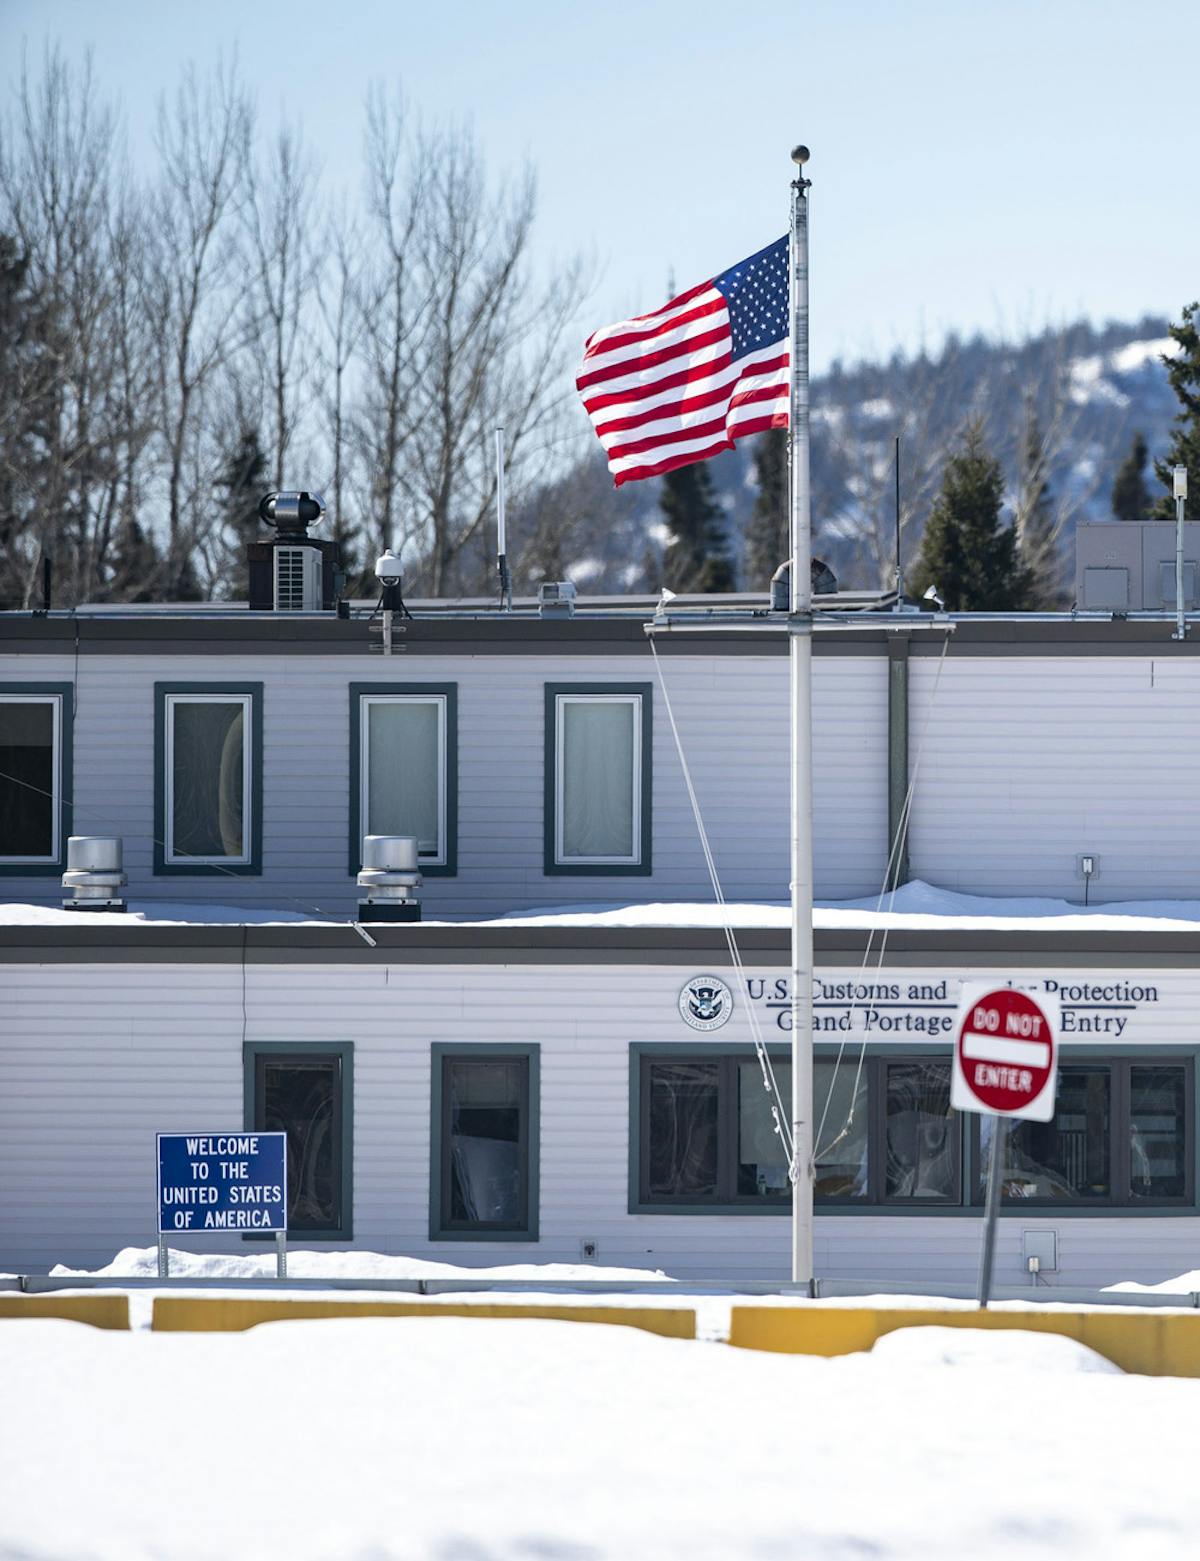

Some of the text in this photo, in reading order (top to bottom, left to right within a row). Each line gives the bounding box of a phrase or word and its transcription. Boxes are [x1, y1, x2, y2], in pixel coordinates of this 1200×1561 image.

[746, 979, 793, 1000] U.S.
[908, 981, 947, 1001] and
[1044, 980, 1160, 1002] Protection
[777, 1010, 1128, 1037] Gand Portage Entry
[973, 1007, 1044, 1038] DO NOT
[974, 1064, 1033, 1094] ENTER
[186, 1137, 259, 1155] WELCOME
[190, 1162, 249, 1180] TO THE
[163, 1185, 282, 1204] UNITED STATES
[174, 1209, 272, 1228] OF AMERICA
